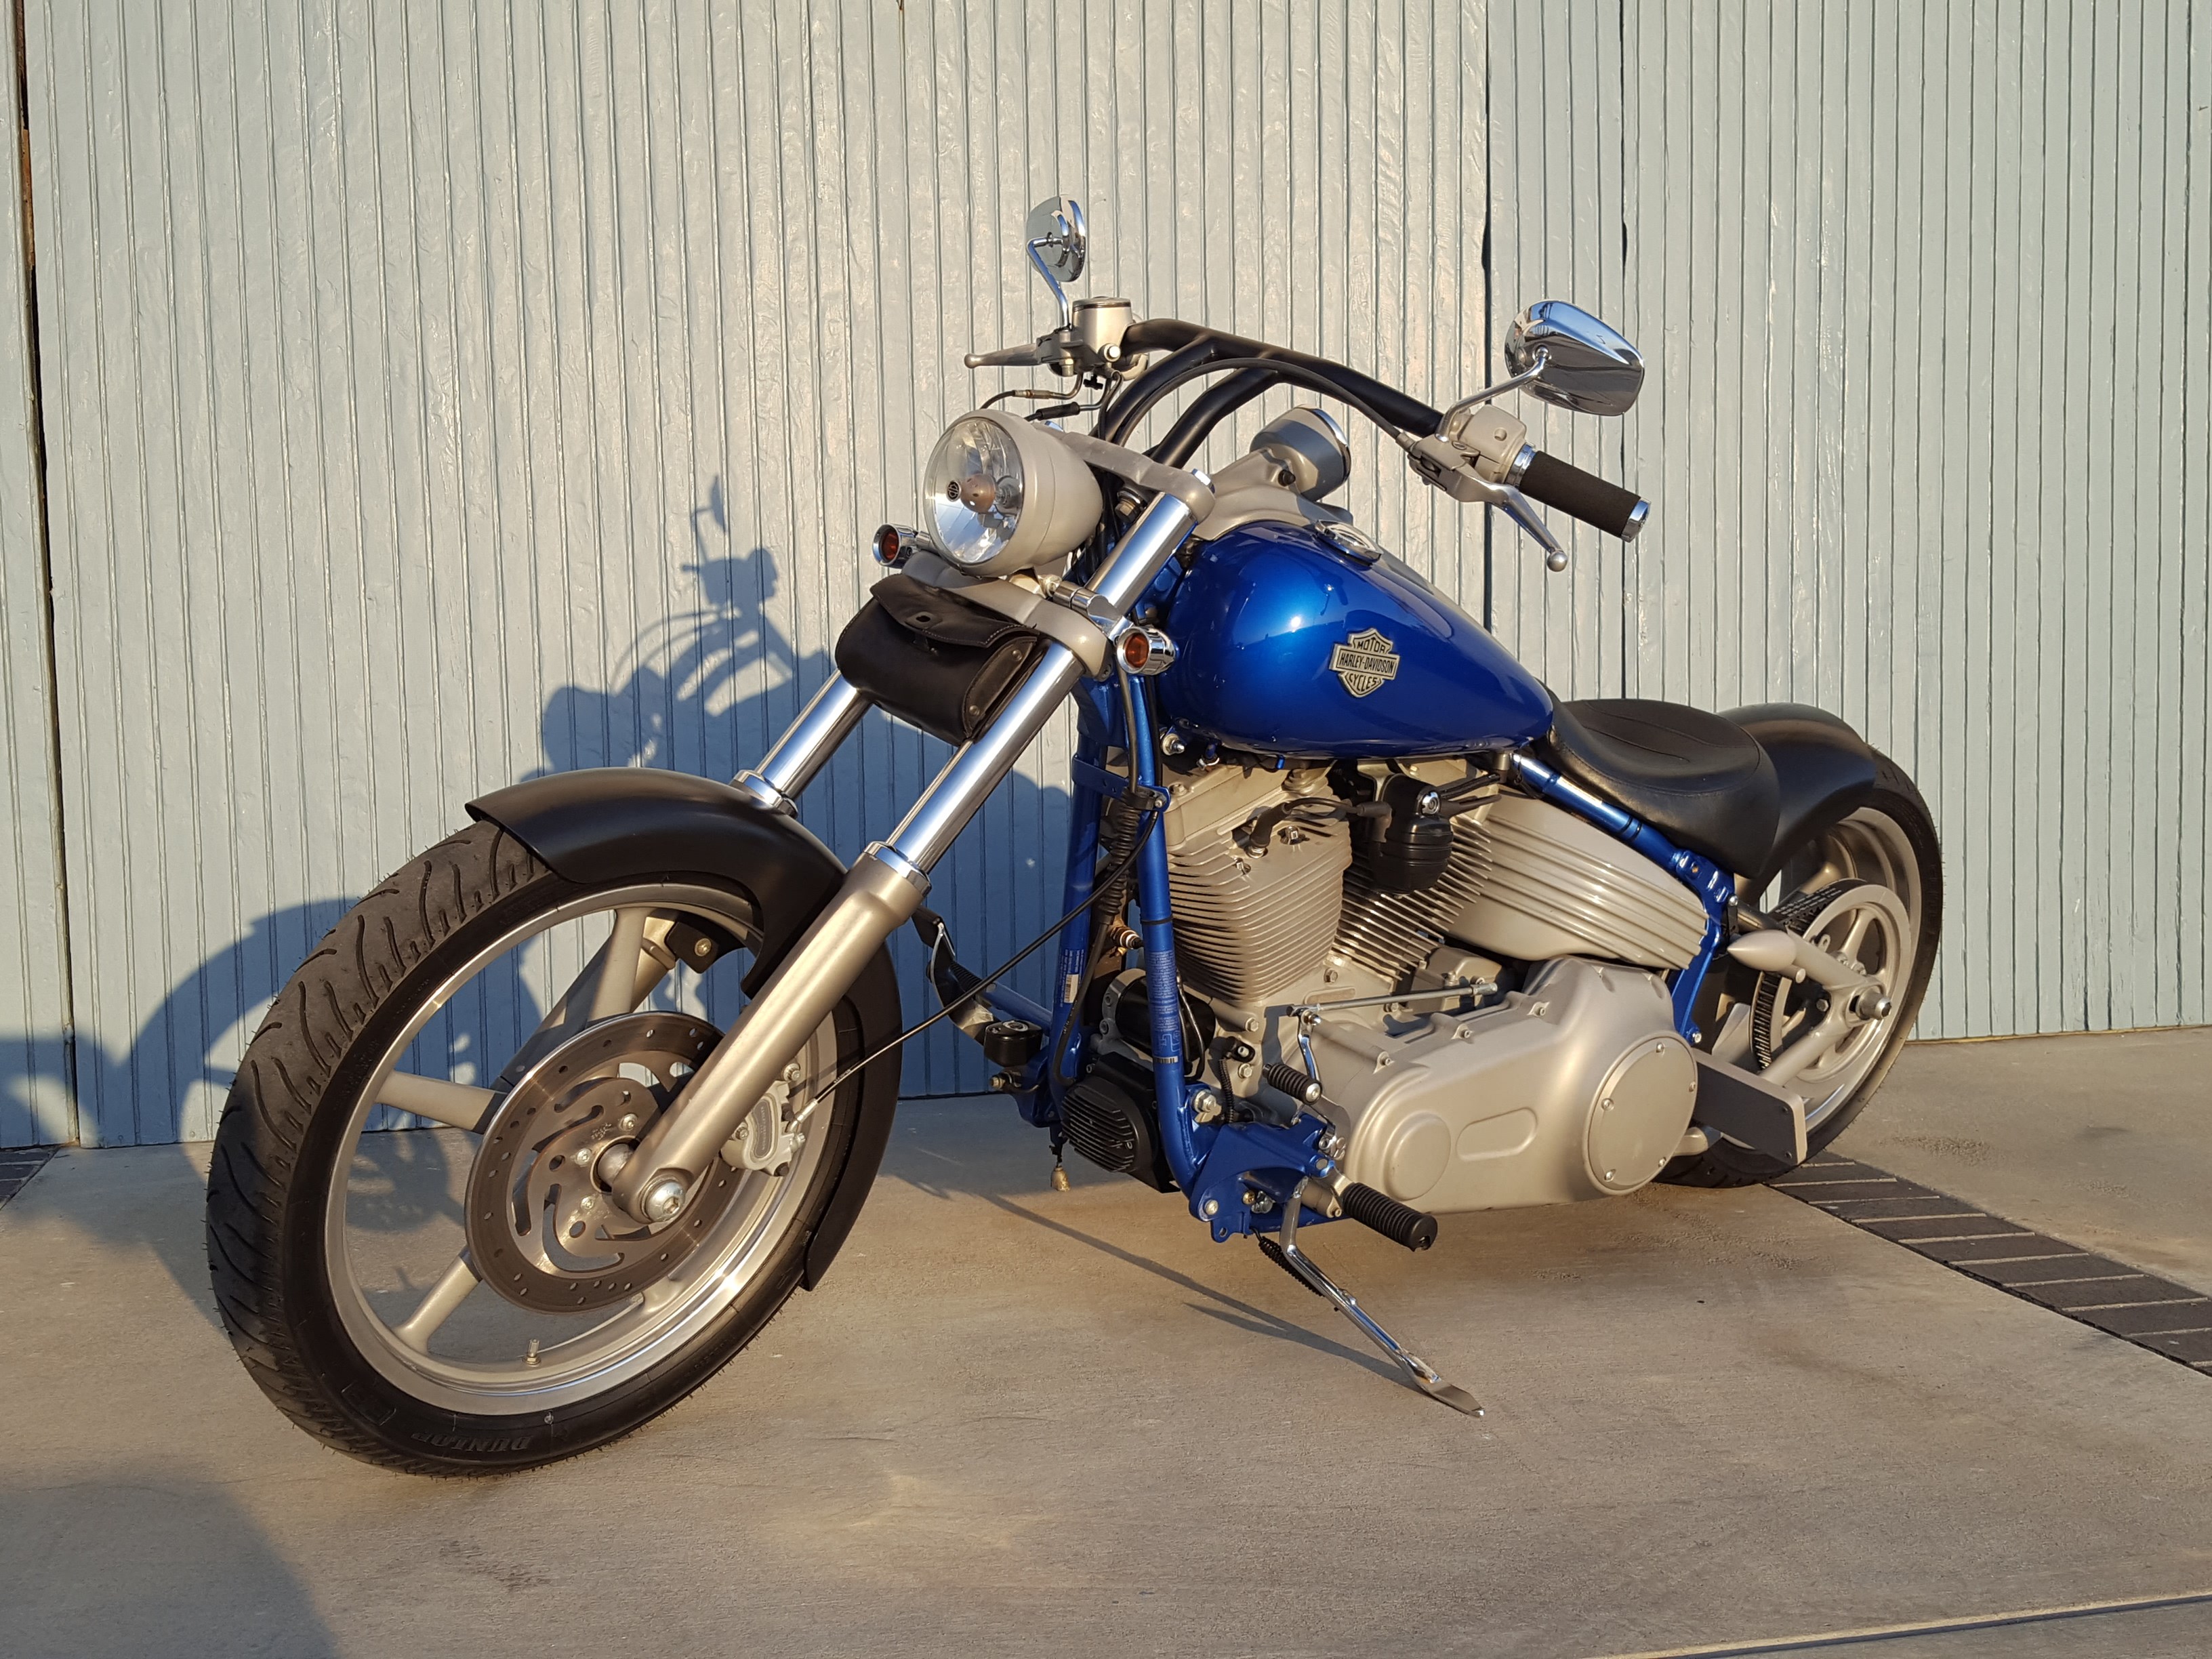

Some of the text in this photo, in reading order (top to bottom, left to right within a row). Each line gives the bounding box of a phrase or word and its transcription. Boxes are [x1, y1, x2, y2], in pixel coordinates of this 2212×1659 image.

[1357, 638, 1386, 653] MOTOR
[1340, 653, 1395, 674] HARLEY-DAVIDSON
[1349, 674, 1376, 692] CYCLES
[410, 1433, 533, 1452] DUNLOP
